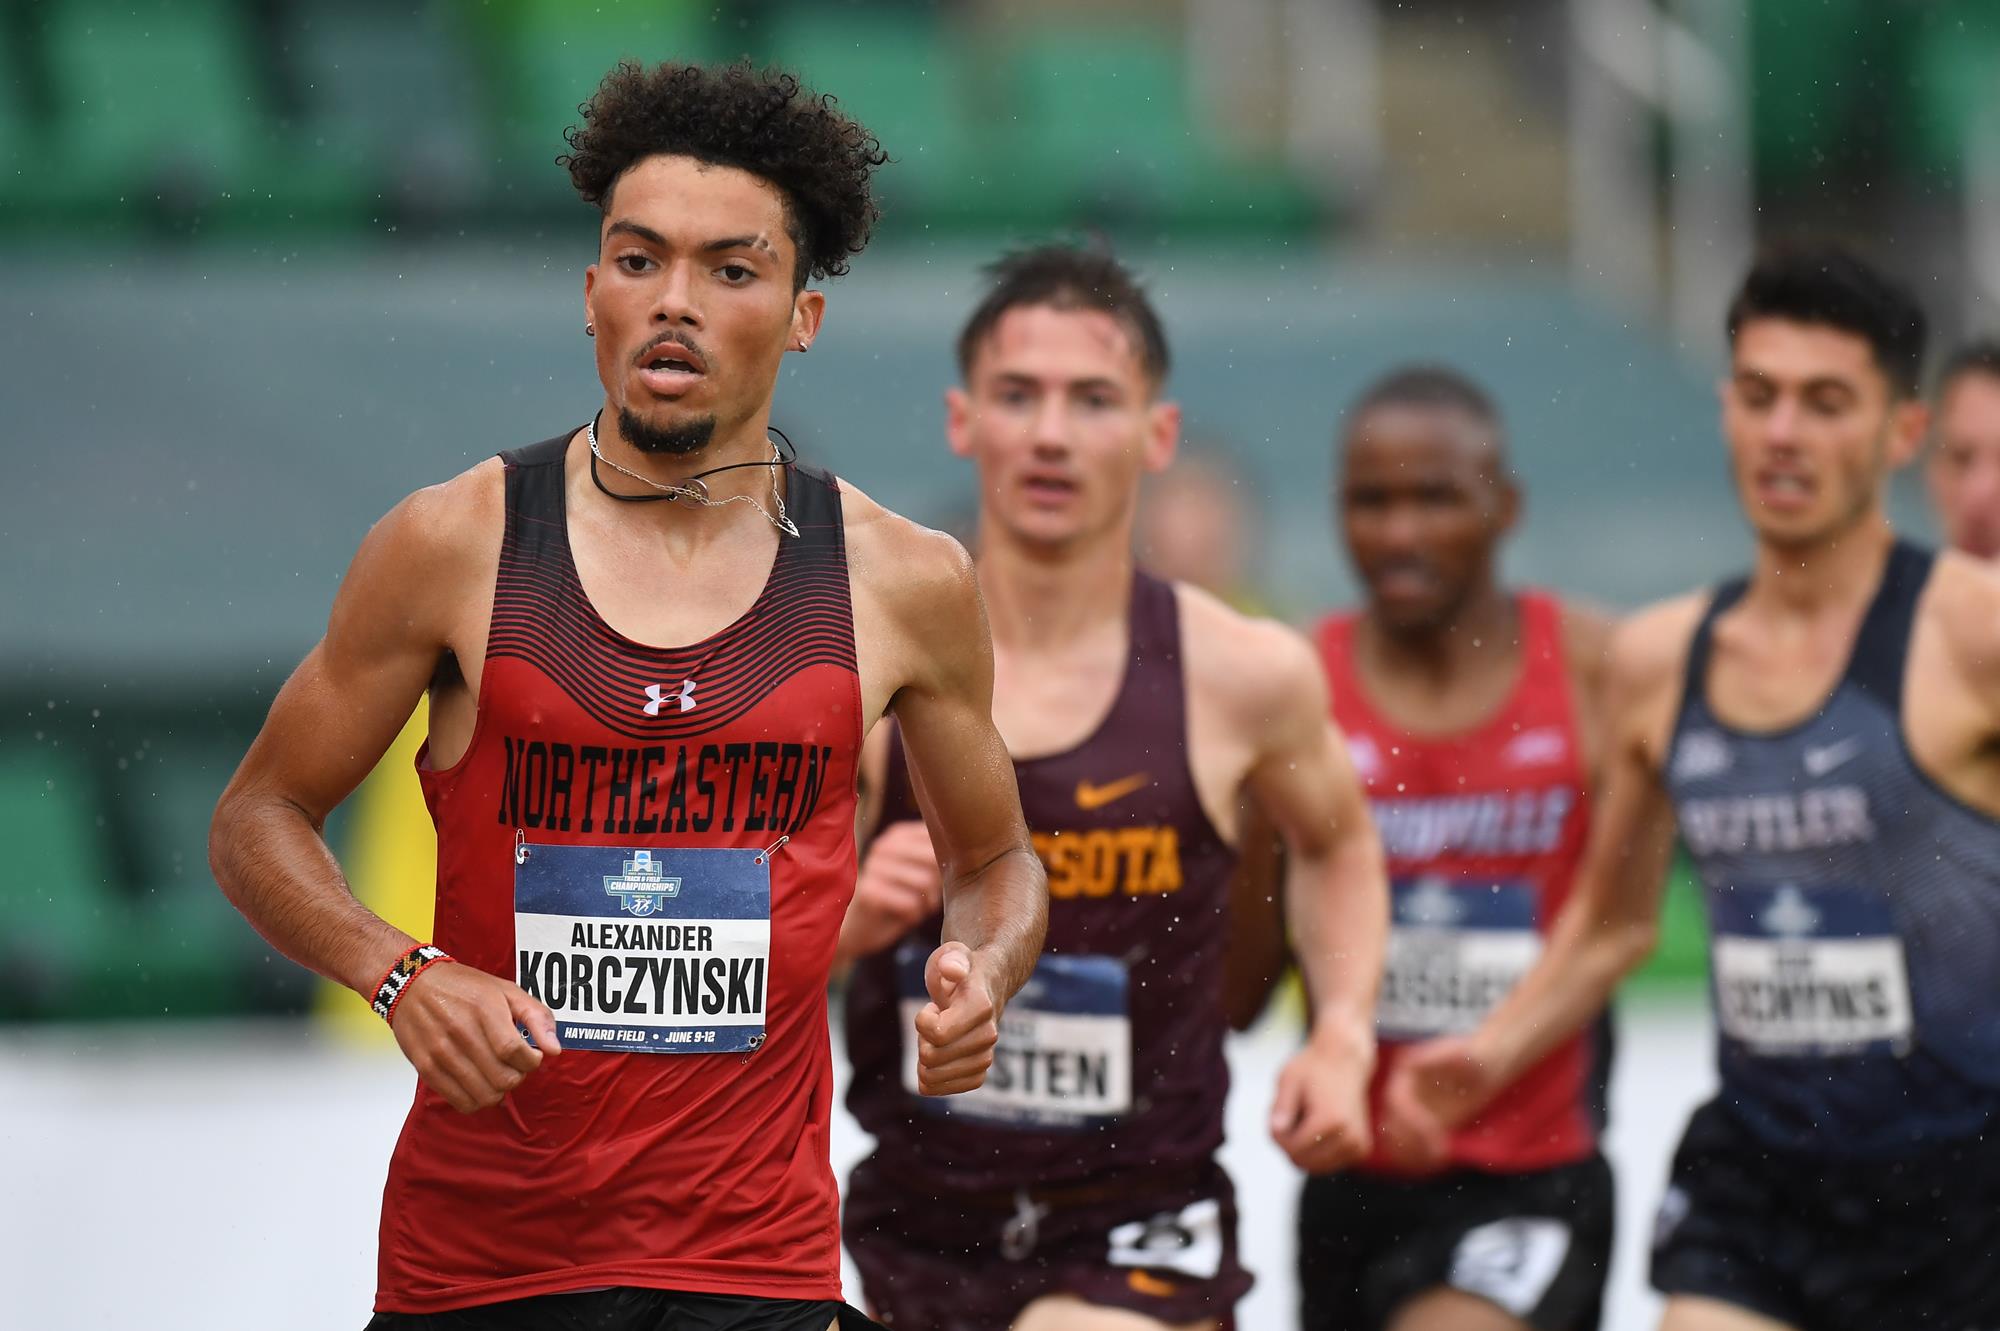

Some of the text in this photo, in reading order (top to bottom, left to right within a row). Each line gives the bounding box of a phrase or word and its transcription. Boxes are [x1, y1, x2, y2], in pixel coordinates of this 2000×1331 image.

[498, 735, 832, 835] NORTHEASTERN
[610, 881, 675, 892] CHAMPIONSHIPS
[571, 922, 713, 952] ALEXANDER
[519, 950, 765, 1016] KORCZYNSKI
[564, 1026, 716, 1043] HAYWARD FIELD JUNE 9-12
